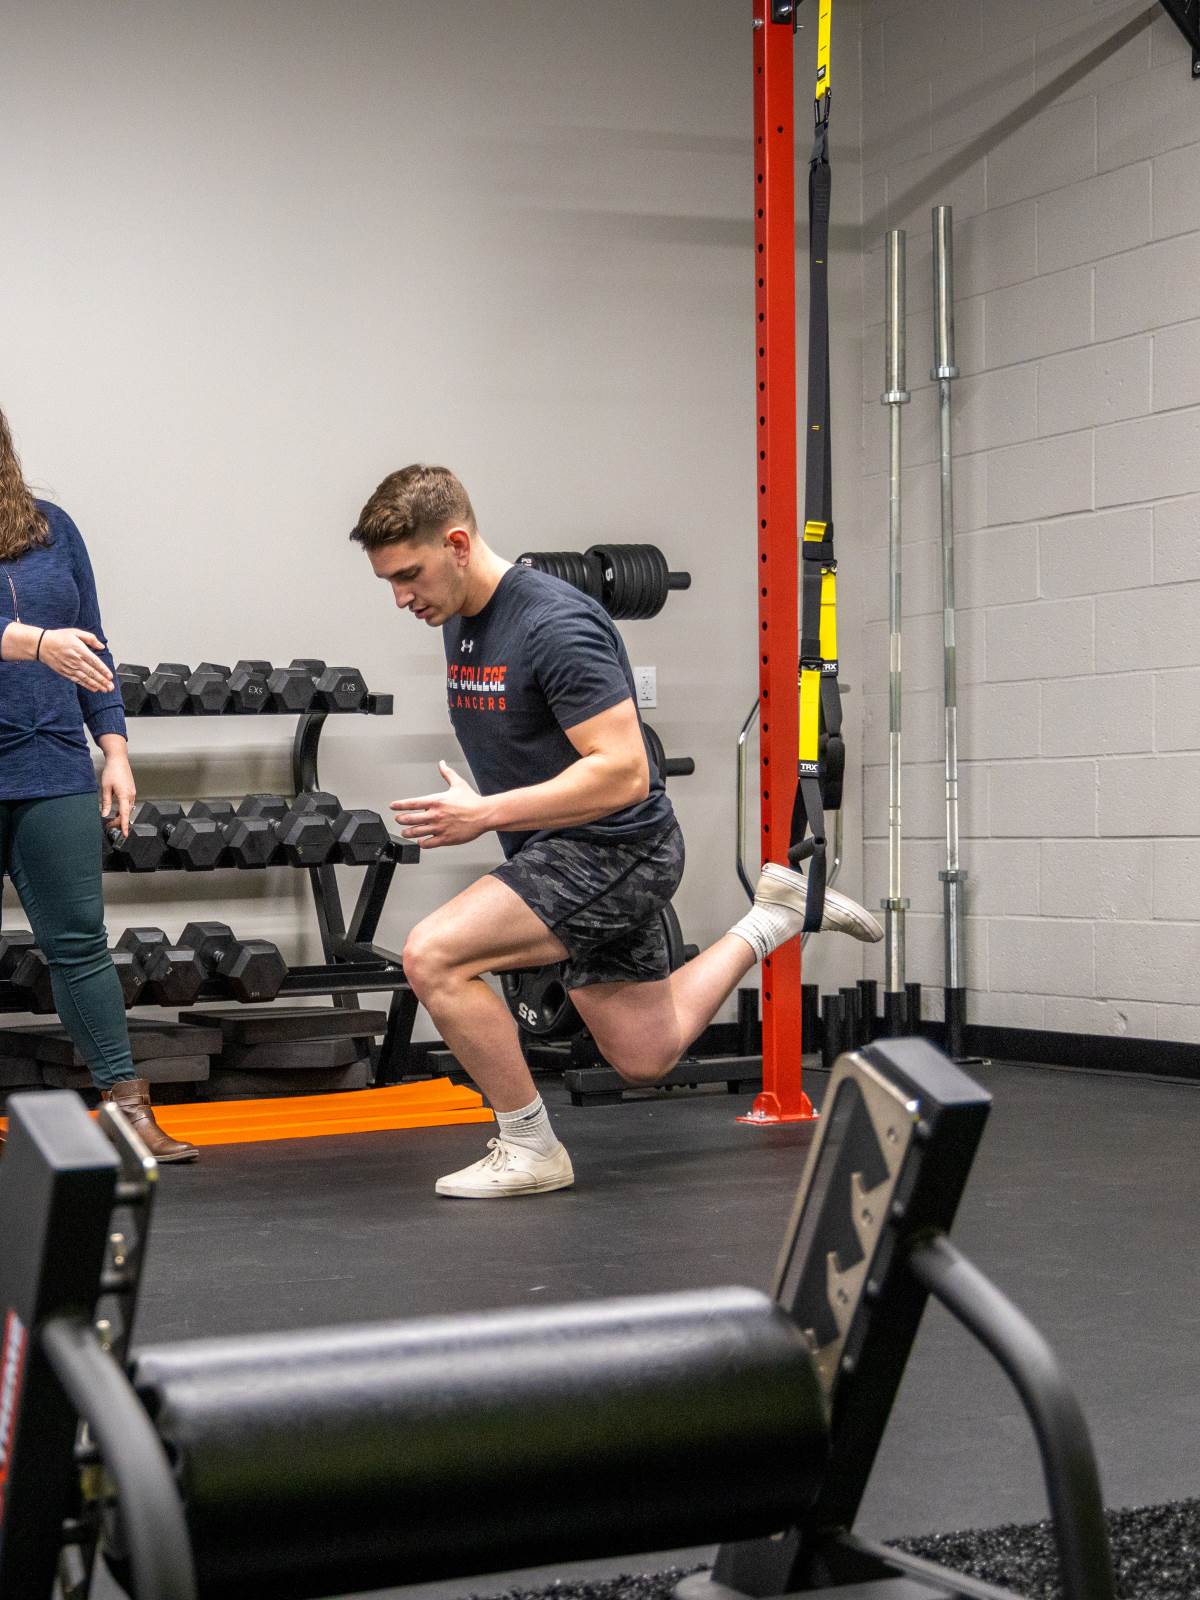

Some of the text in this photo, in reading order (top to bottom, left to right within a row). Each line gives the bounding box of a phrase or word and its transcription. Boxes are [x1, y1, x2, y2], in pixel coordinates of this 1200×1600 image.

[460, 664, 507, 692] COLLEGE
[449, 694, 507, 711] LANCERS
[800, 763, 819, 772] TRX
